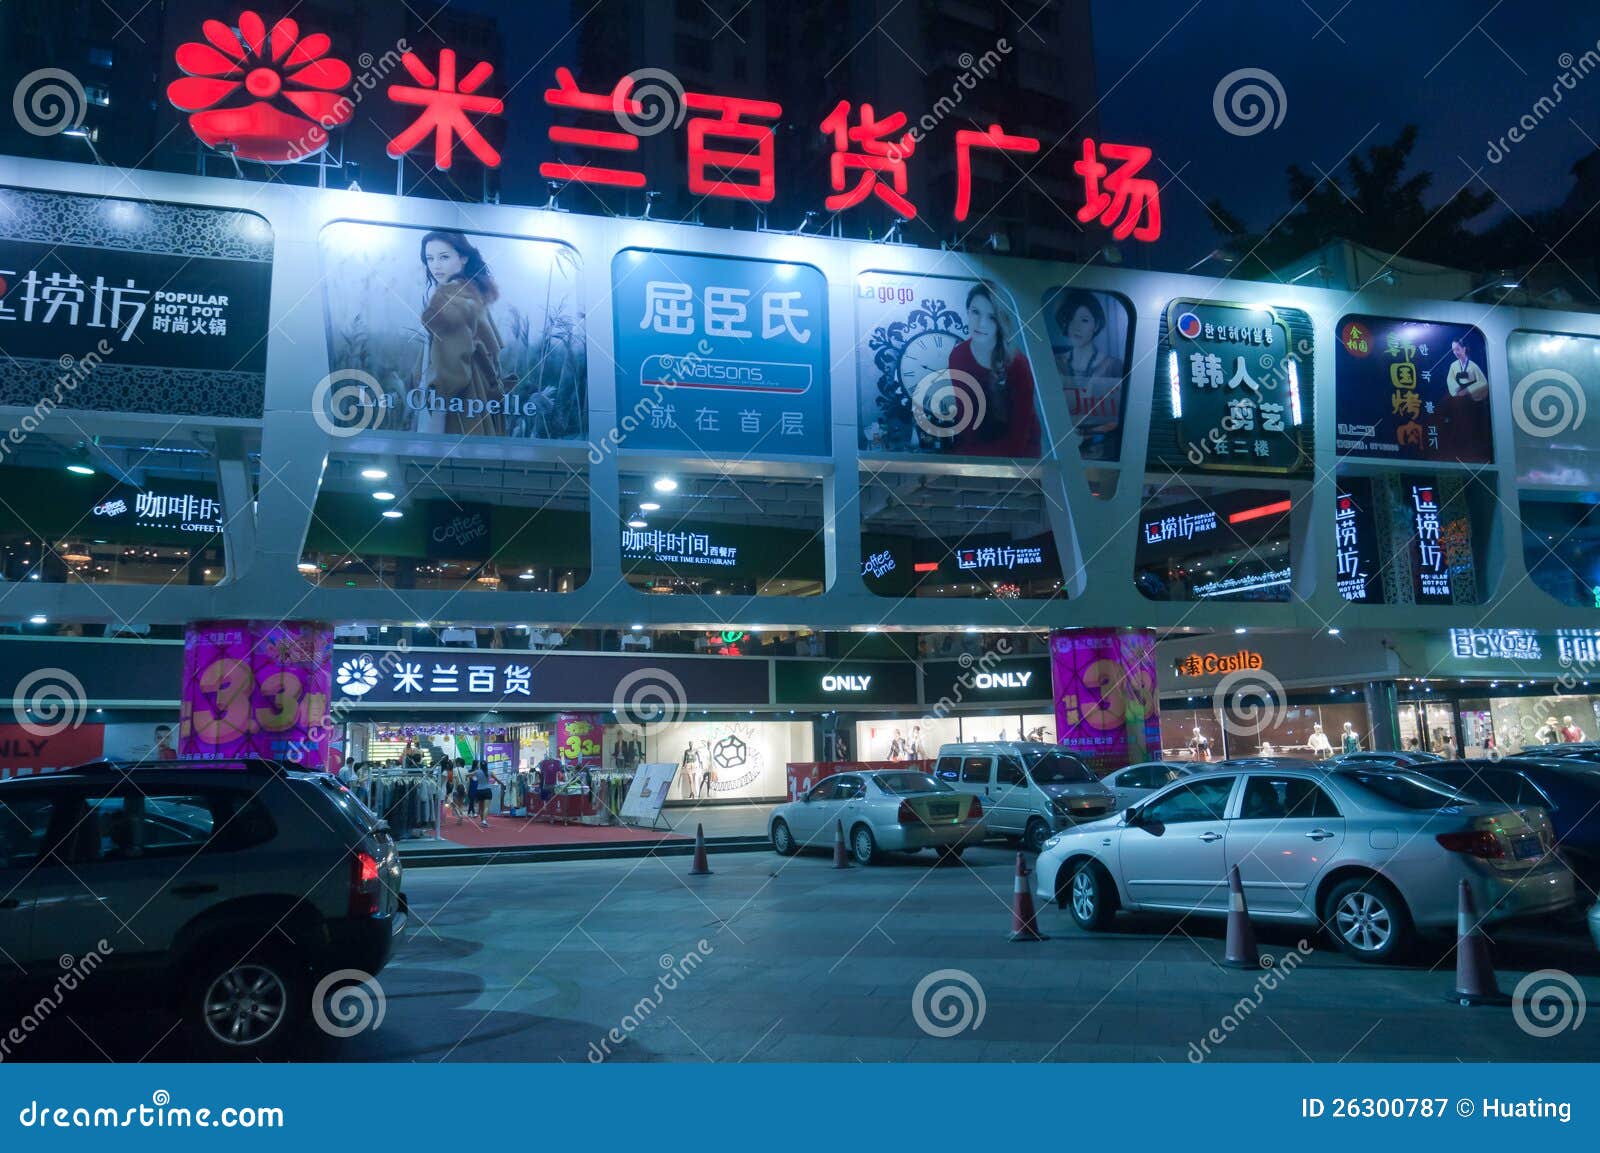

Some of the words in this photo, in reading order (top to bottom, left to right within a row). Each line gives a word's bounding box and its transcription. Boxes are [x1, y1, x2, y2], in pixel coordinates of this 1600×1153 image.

[387, 48, 1163, 242] 米兰百货广场
[0, 270, 150, 342] 捞坊
[154, 303, 188, 315] HOT
[191, 306, 223, 318] POT
[155, 291, 229, 306] POPULAR
[639, 280, 811, 343] 屈臣氏
[152, 315, 227, 336] 时尚火锅
[1189, 352, 1260, 389] 韩人
[356, 386, 394, 408] La
[406, 388, 537, 418] Chapelle
[650, 404, 804, 436] 就在首层
[180, 523, 214, 533] COFFEE
[622, 528, 709, 556] 咖啡时间
[393, 662, 532, 696] 米兰百货
[821, 675, 872, 692] ONLY
[975, 671, 1032, 689] ONLY
